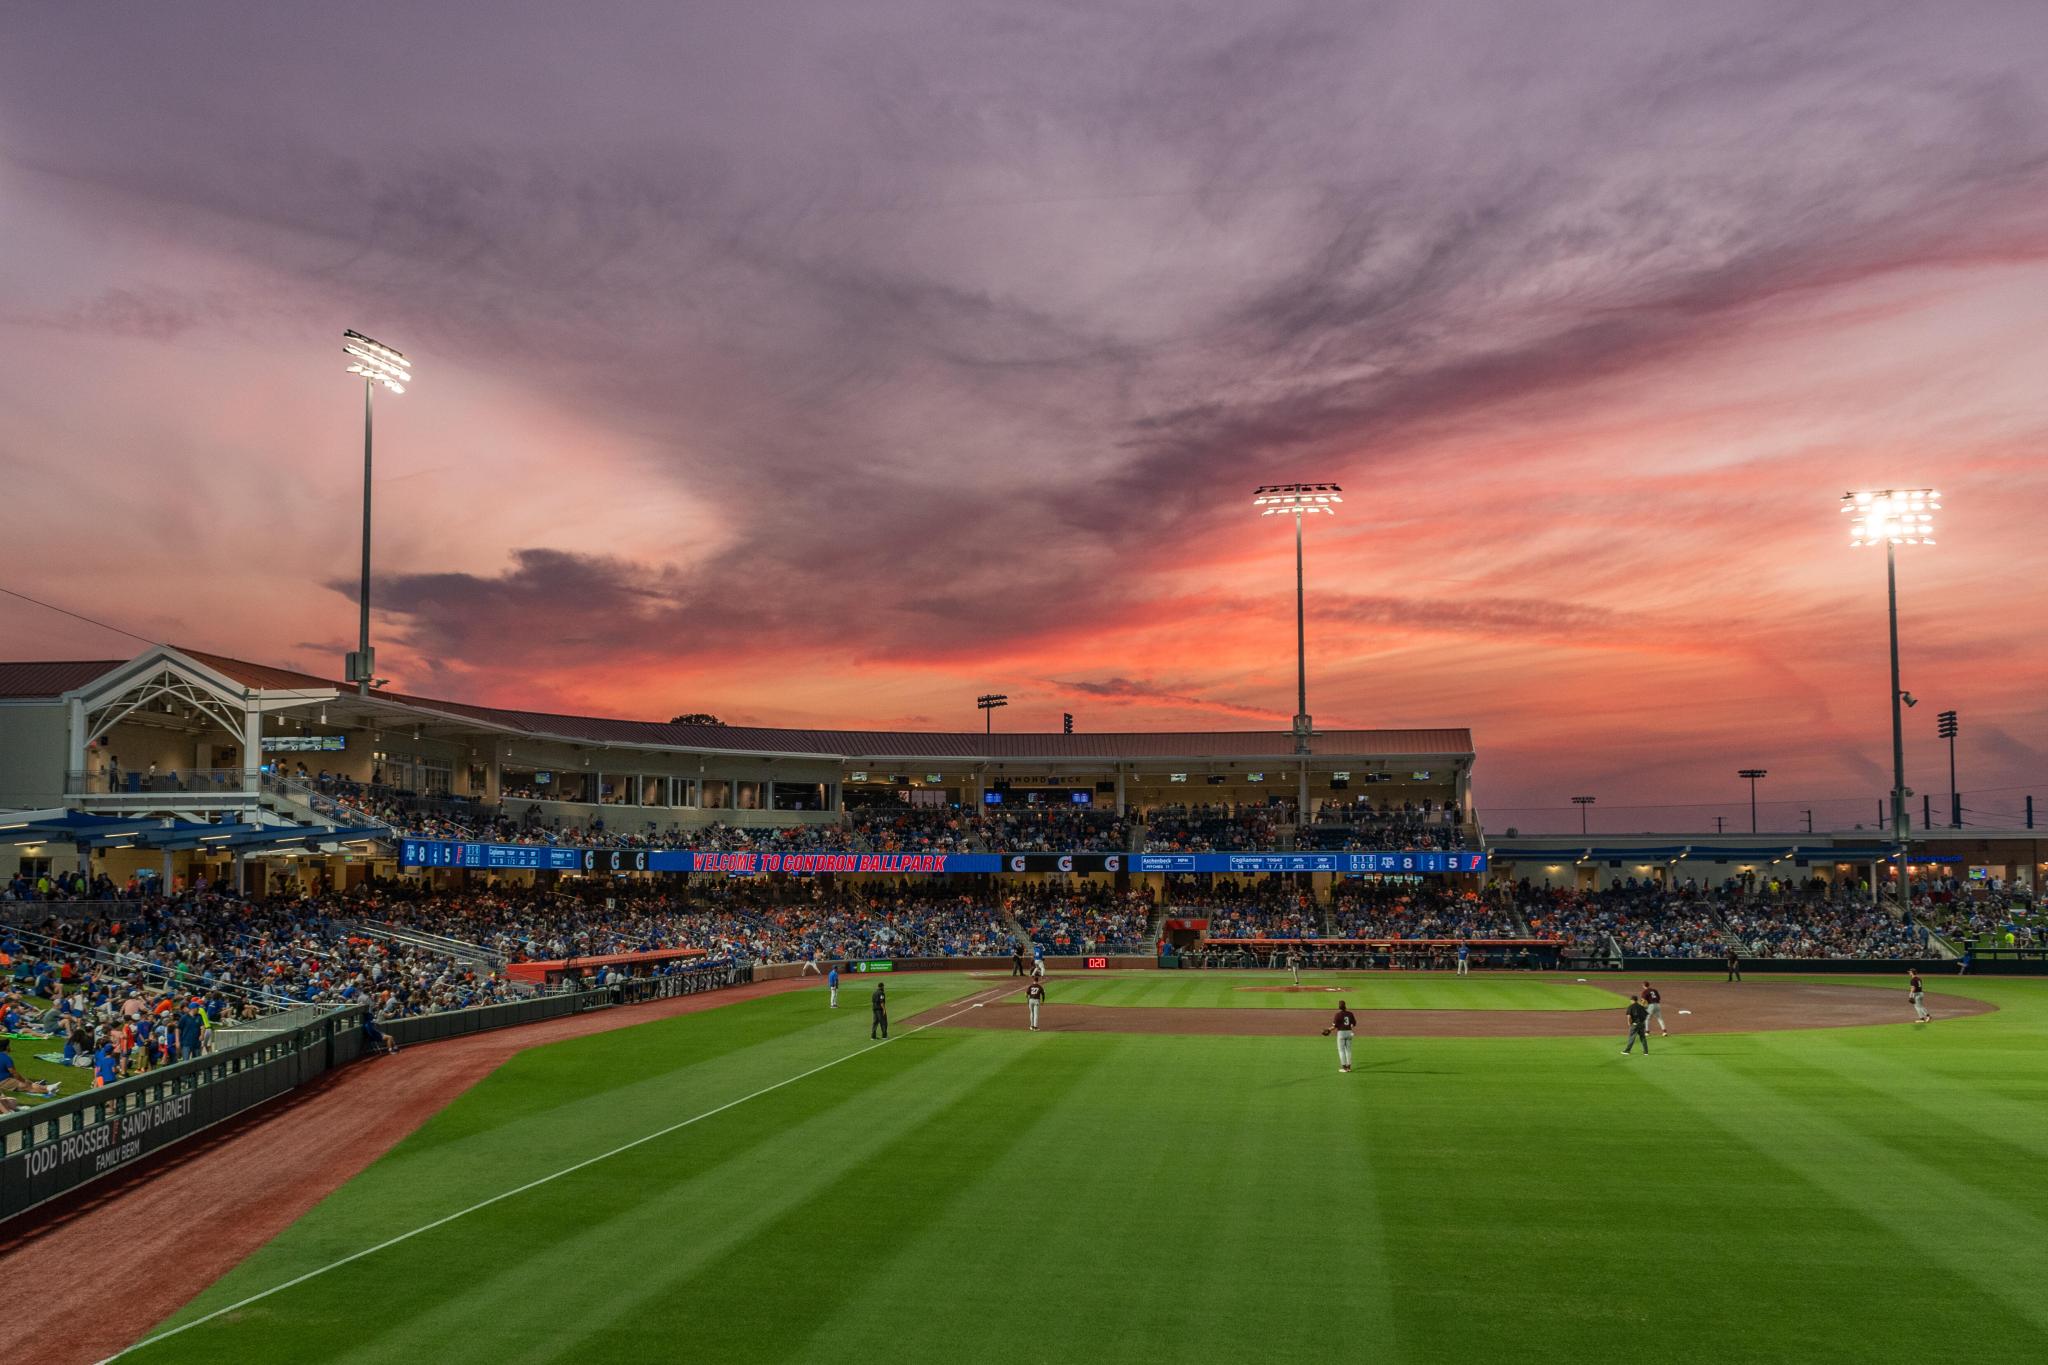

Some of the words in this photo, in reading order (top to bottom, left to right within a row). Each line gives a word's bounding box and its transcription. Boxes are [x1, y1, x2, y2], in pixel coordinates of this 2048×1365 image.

[419, 846, 426, 862] 8
[444, 848, 451, 863] 5
[585, 851, 594, 870] G
[611, 852, 620, 870] G
[636, 852, 645, 870] G
[693, 853, 757, 871] WELCOME
[761, 854, 781, 871] TO
[782, 855, 857, 871] CONDRON
[859, 855, 948, 871] BALLPARK
[1010, 856, 1025, 872] G
[1058, 856, 1072, 872] G
[1105, 856, 1119, 872] G
[1403, 858, 1413, 869] 8
[1448, 858, 1458, 868] 5
[1470, 856, 1481, 869] F
[1089, 958, 1105, 968] 020
[1031, 987, 1039, 995] 27
[1344, 1016, 1349, 1025] 3
[24, 1144, 57, 1179] TODD
[61, 1125, 110, 1164] PROSSER
[121, 1108, 153, 1140] SANDY
[154, 1093, 193, 1127] BURNETT
[96, 1149, 121, 1171] FAMILY
[121, 1140, 140, 1161] BERM
